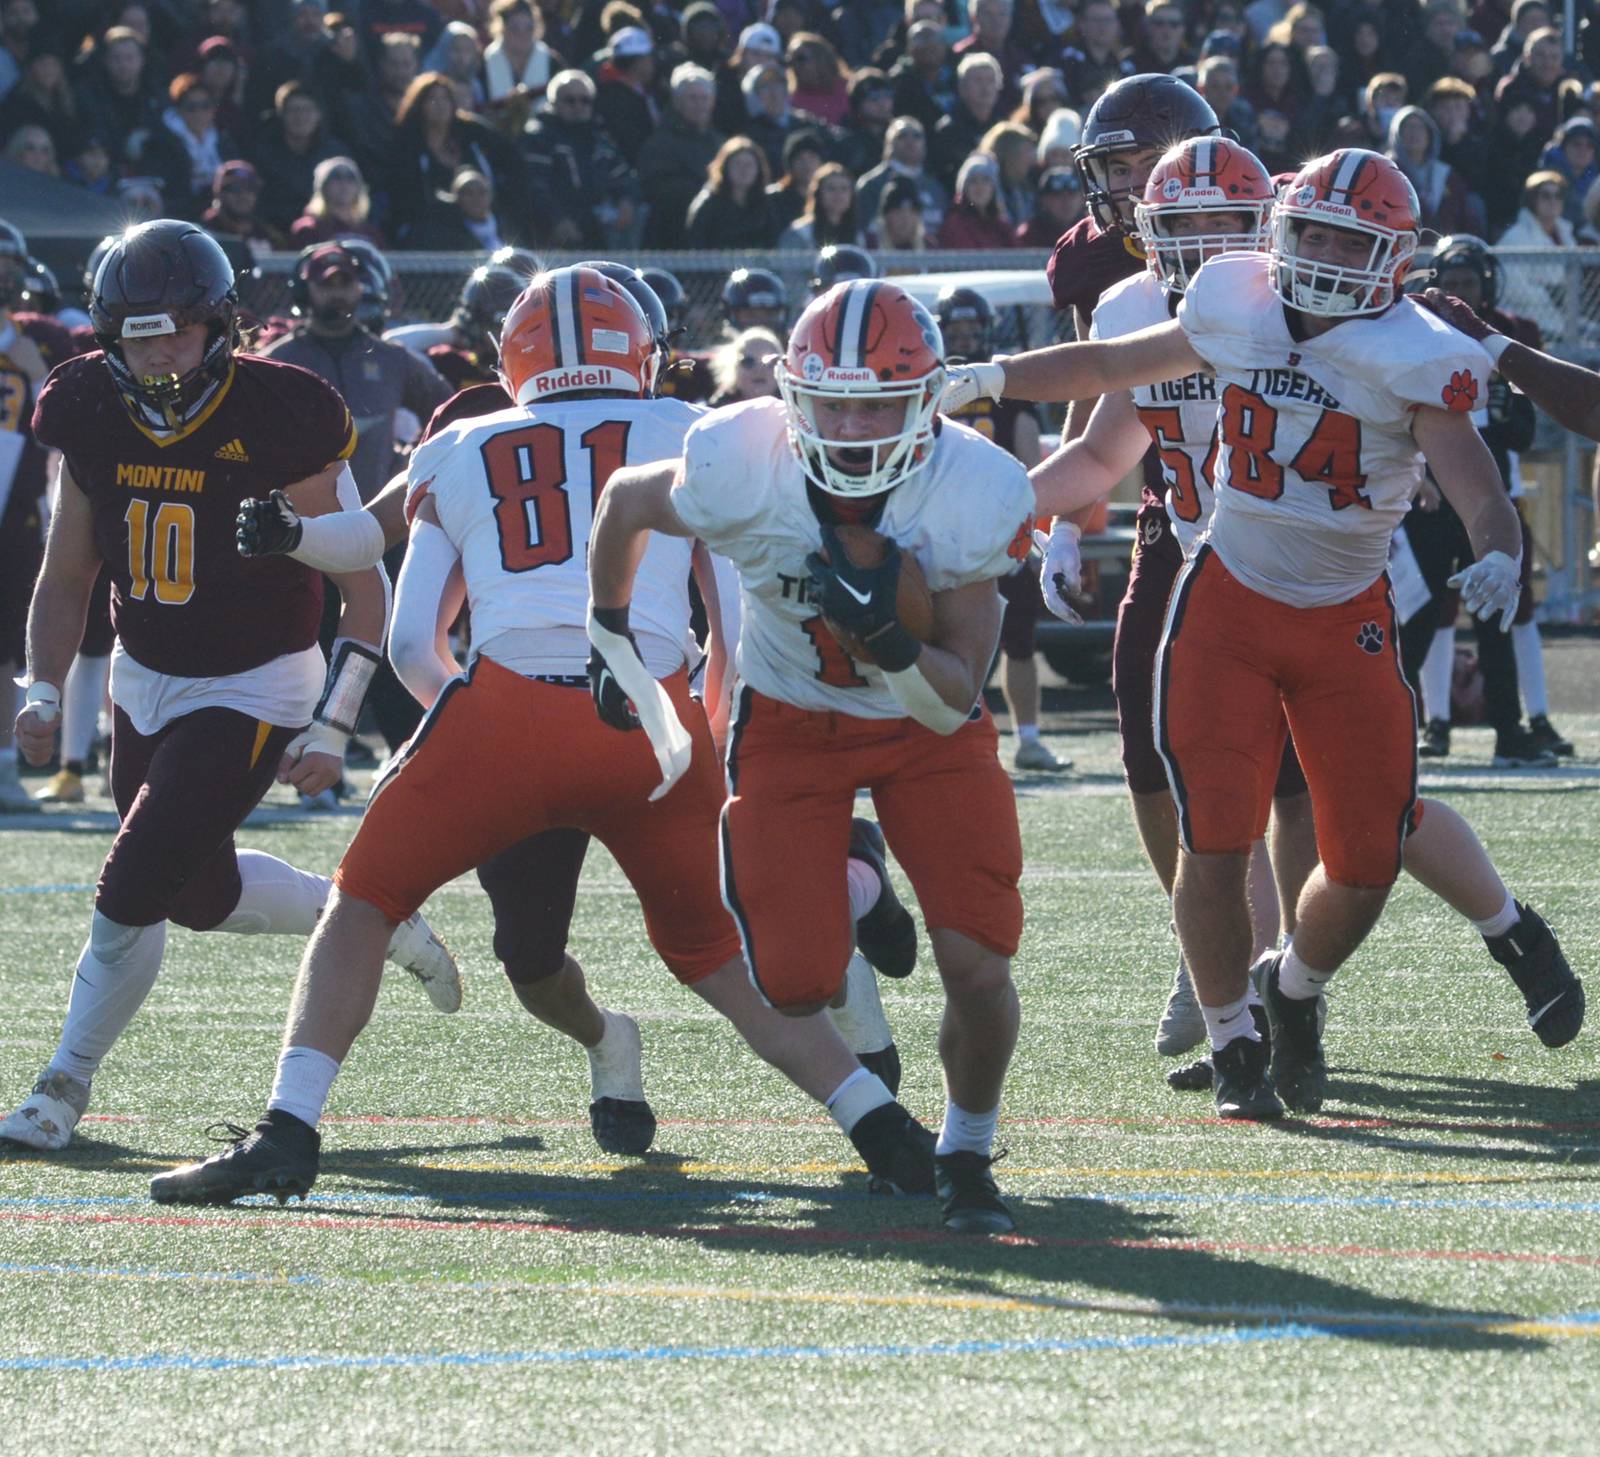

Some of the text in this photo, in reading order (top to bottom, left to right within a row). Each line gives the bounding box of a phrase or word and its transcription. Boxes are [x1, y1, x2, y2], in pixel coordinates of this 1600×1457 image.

[1315, 203, 1352, 216] Riddell
[129, 320, 162, 330] MONTINI
[535, 369, 612, 393] Riddell
[827, 370, 870, 381] Riddell
[1150, 372, 1217, 401] TIGER
[214, 450, 250, 463] adidas
[1221, 382, 1373, 511] 84
[1136, 405, 1217, 523] 5
[116, 463, 206, 493] MONTINI
[124, 498, 196, 605] 10
